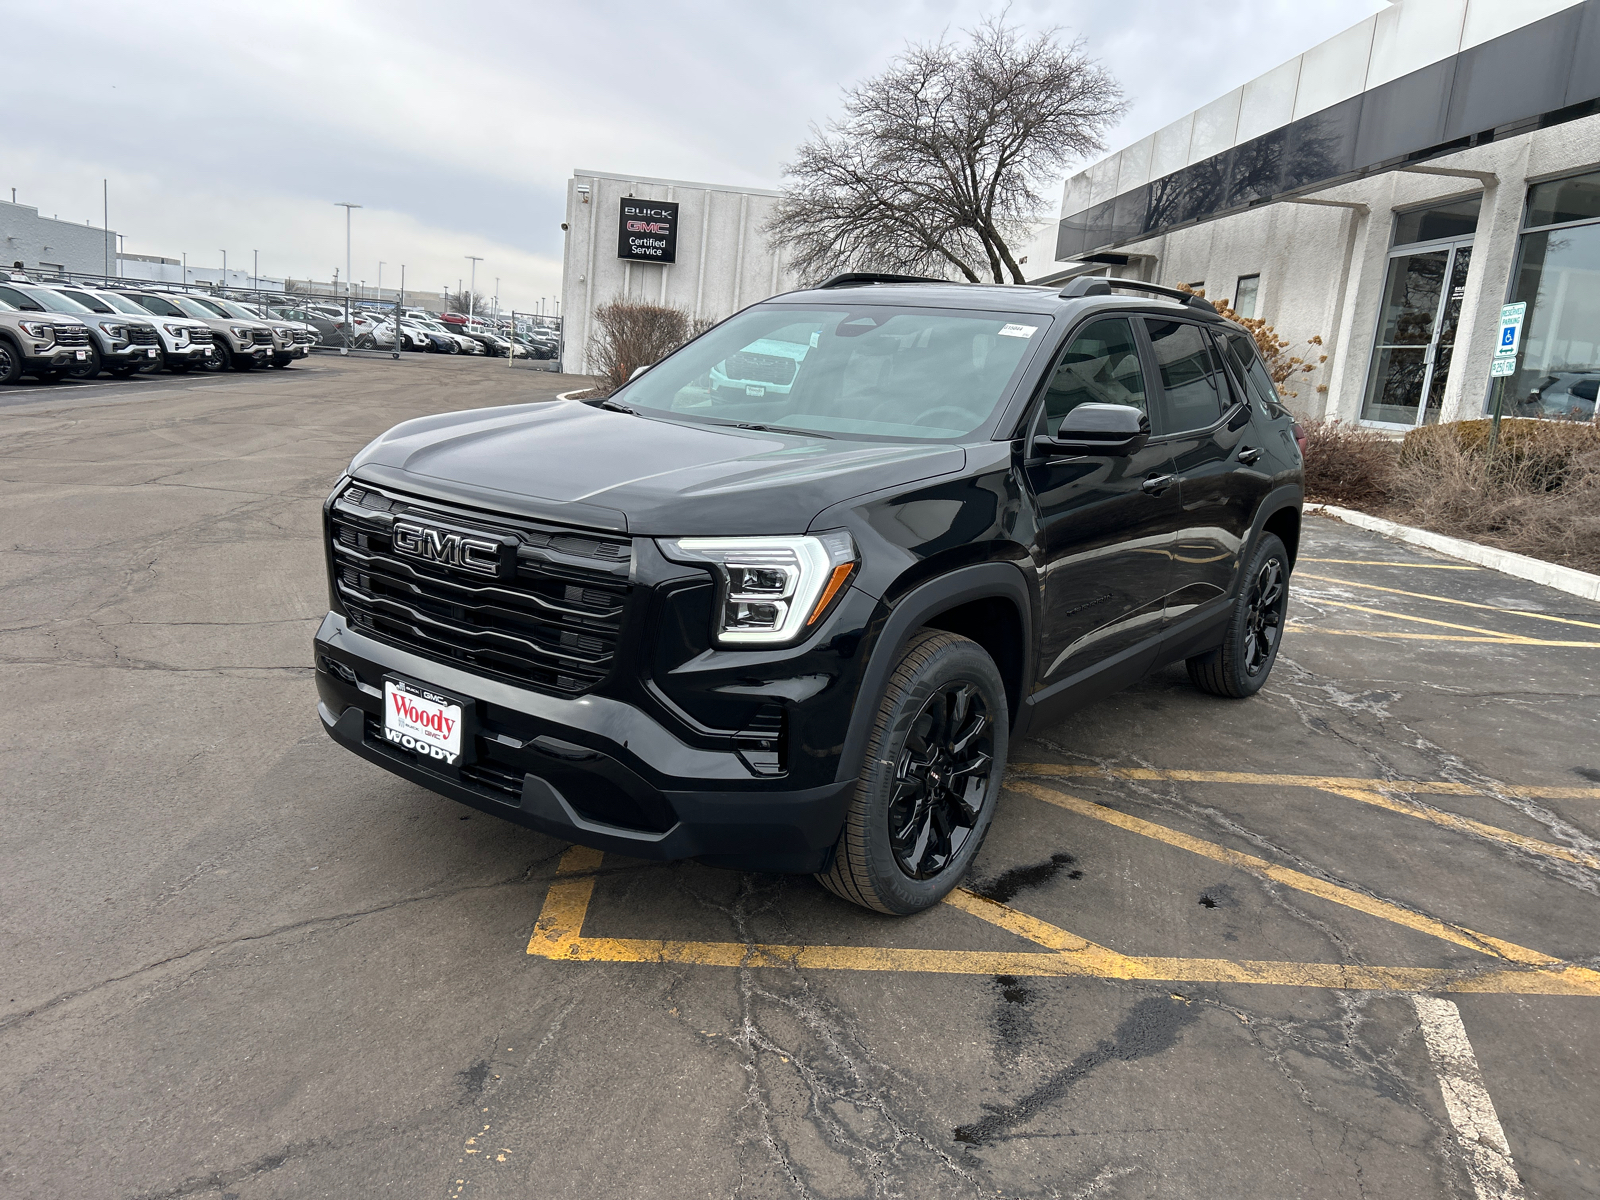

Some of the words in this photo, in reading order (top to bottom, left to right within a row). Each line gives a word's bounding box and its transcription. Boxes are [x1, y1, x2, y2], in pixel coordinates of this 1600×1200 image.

[625, 206, 672, 219] BUICK
[626, 220, 670, 235] GMC
[629, 237, 666, 248] Certified
[631, 245, 663, 256] Service
[393, 522, 501, 578] GMC
[423, 691, 445, 703] GMC
[391, 692, 456, 740] Woody
[384, 727, 458, 765] WOODY
